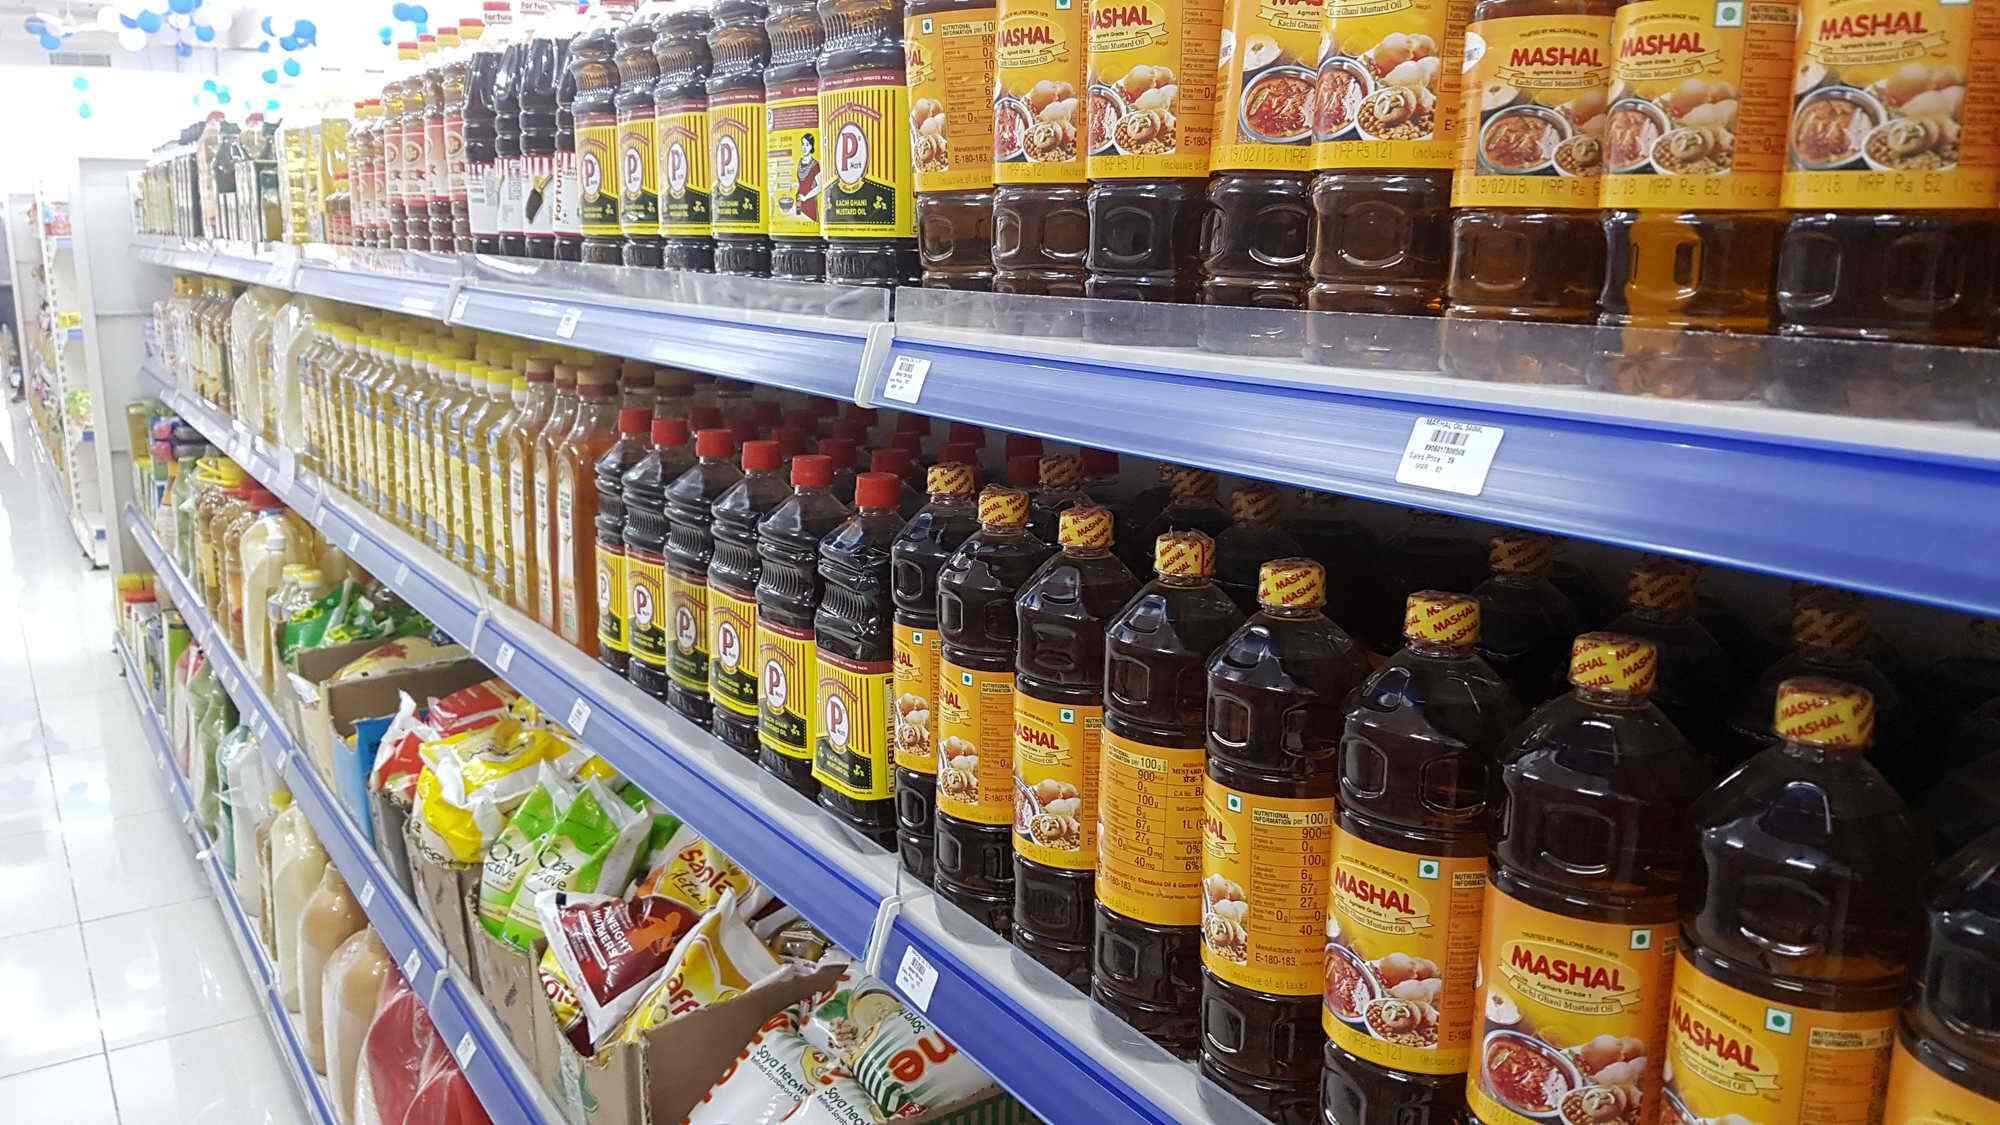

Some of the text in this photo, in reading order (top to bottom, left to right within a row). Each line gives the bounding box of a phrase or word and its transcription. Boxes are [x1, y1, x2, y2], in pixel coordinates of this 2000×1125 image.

[1360, 5, 1390, 15] Mustard
[1277, 18, 1320, 30] Kachi Ghani
[1818, 11, 1928, 41] MASHAL
[1135, 38, 1146, 47] Oil
[1621, 31, 1706, 58] MASHAL
[1510, 47, 1602, 67] MASHAL
[841, 133, 859, 171] P
[1280, 579, 1317, 605] MASHAL
[1432, 603, 1475, 633] MASHAL
[768, 664, 781, 696] P
[830, 698, 843, 734] P
[1785, 714, 1845, 738] MASHAL
[1015, 720, 1060, 751] ASHAL
[1137, 770, 1155, 782] 900
[1253, 809, 1290, 819] NUTRITIONAL
[1253, 815, 1292, 825] INFORMATION
[1301, 827, 1322, 839] 900
[1185, 861, 1200, 871] 6%
[1335, 866, 1416, 915] MASHAL
[1300, 924, 1313, 936] 40
[1511, 944, 1626, 992] MASHAL
[1516, 982, 1614, 1013] Kachi Ghani Mustard Oil
[1537, 981, 1562, 993] Agmark
[1564, 988, 1586, 998] Grade
[1672, 998, 1760, 1073] MASHAL
[1811, 1038, 1863, 1047] INFORMATION
[1812, 1030, 1862, 1040] NUTRITIONAL
[756, 1043, 780, 1068] Soya
[824, 1086, 846, 1109] Soya
